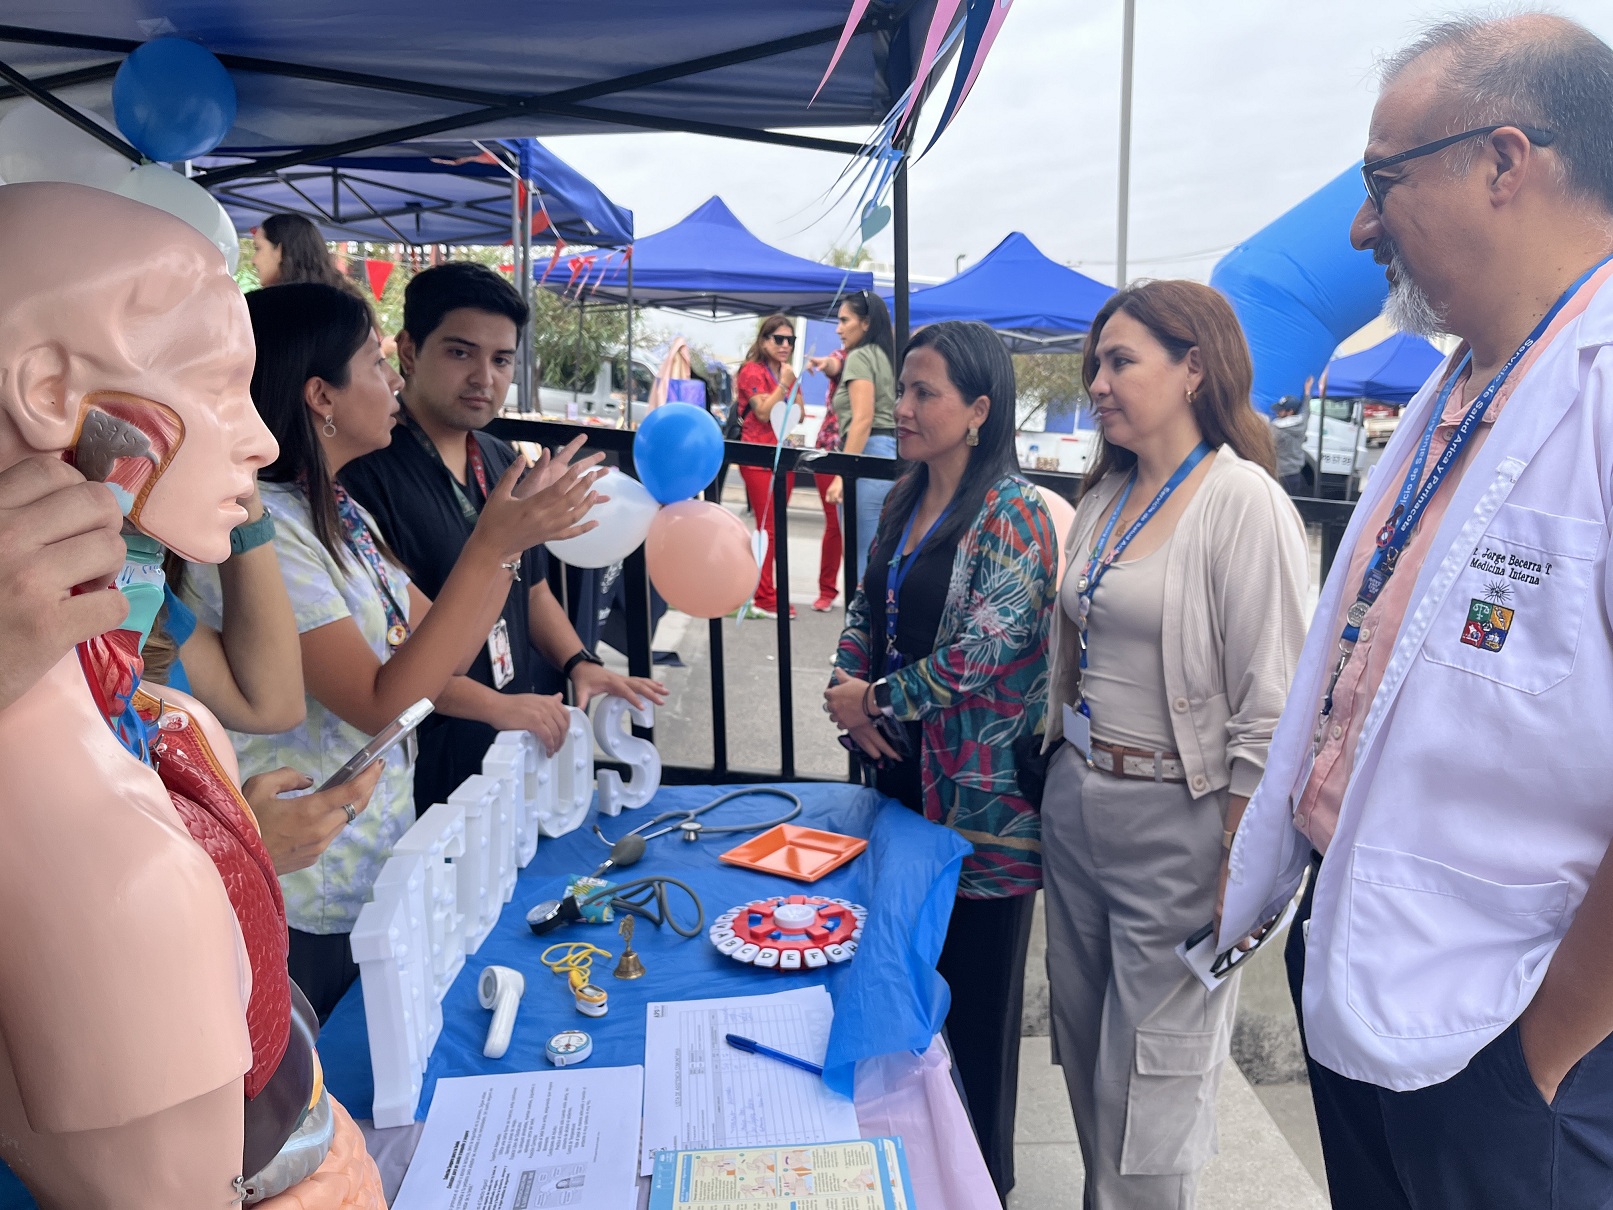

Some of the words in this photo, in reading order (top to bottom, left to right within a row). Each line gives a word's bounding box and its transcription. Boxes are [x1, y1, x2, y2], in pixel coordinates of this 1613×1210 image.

[1495, 338, 1534, 383] Servicio
[1482, 384, 1495, 399] de
[1459, 400, 1485, 434] Salud
[1440, 434, 1463, 467] Arica
[1400, 475, 1440, 533] Parinacota
[1470, 558, 1505, 576] Medicina
[1509, 568, 1540, 586] Interna
[1482, 548, 1506, 564] Jorge
[1508, 554, 1542, 573] Becerra
[761, 952, 772, 960] D
[786, 953, 795, 961] E
[810, 952, 819, 960] F
[832, 947, 842, 956] G
